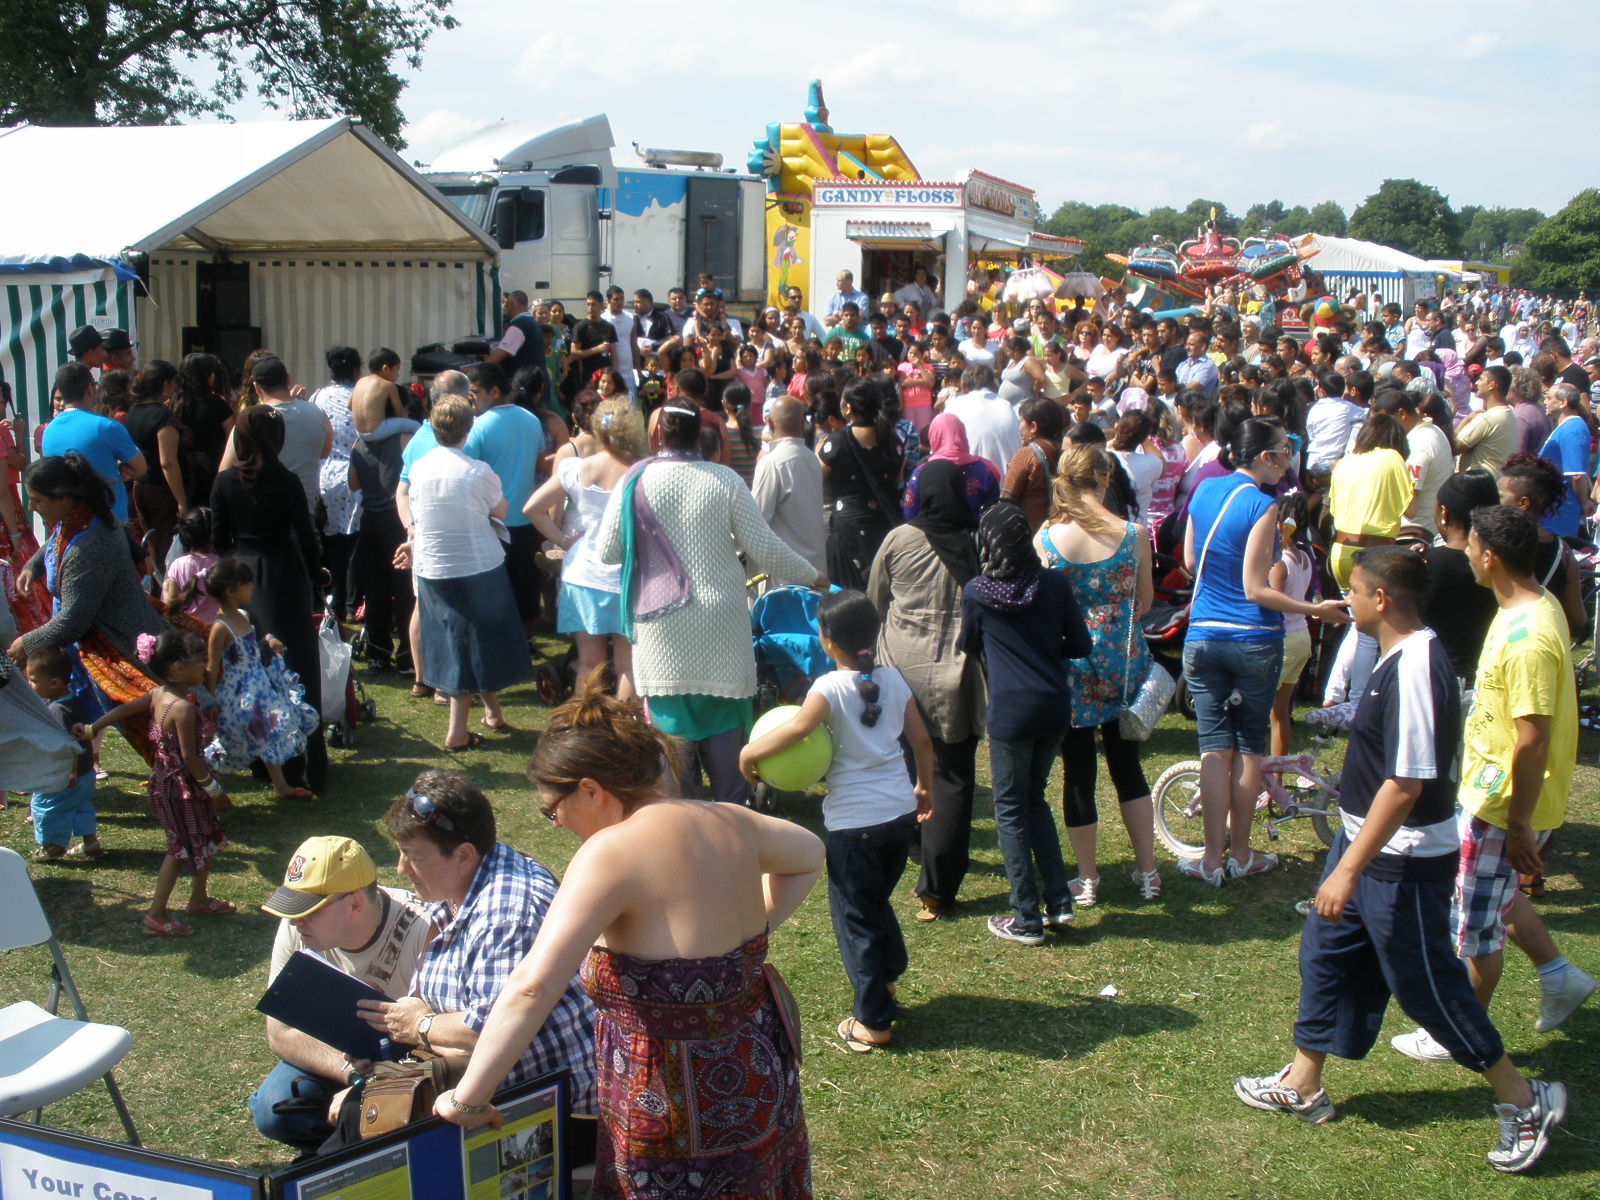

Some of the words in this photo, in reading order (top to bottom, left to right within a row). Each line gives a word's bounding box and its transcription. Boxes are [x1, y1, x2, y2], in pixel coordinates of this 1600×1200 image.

[821, 189, 884, 203] CANDY
[895, 190, 955, 204] FLOSS
[869, 224, 906, 235] CHIPS
[22, 1167, 84, 1199] Your
